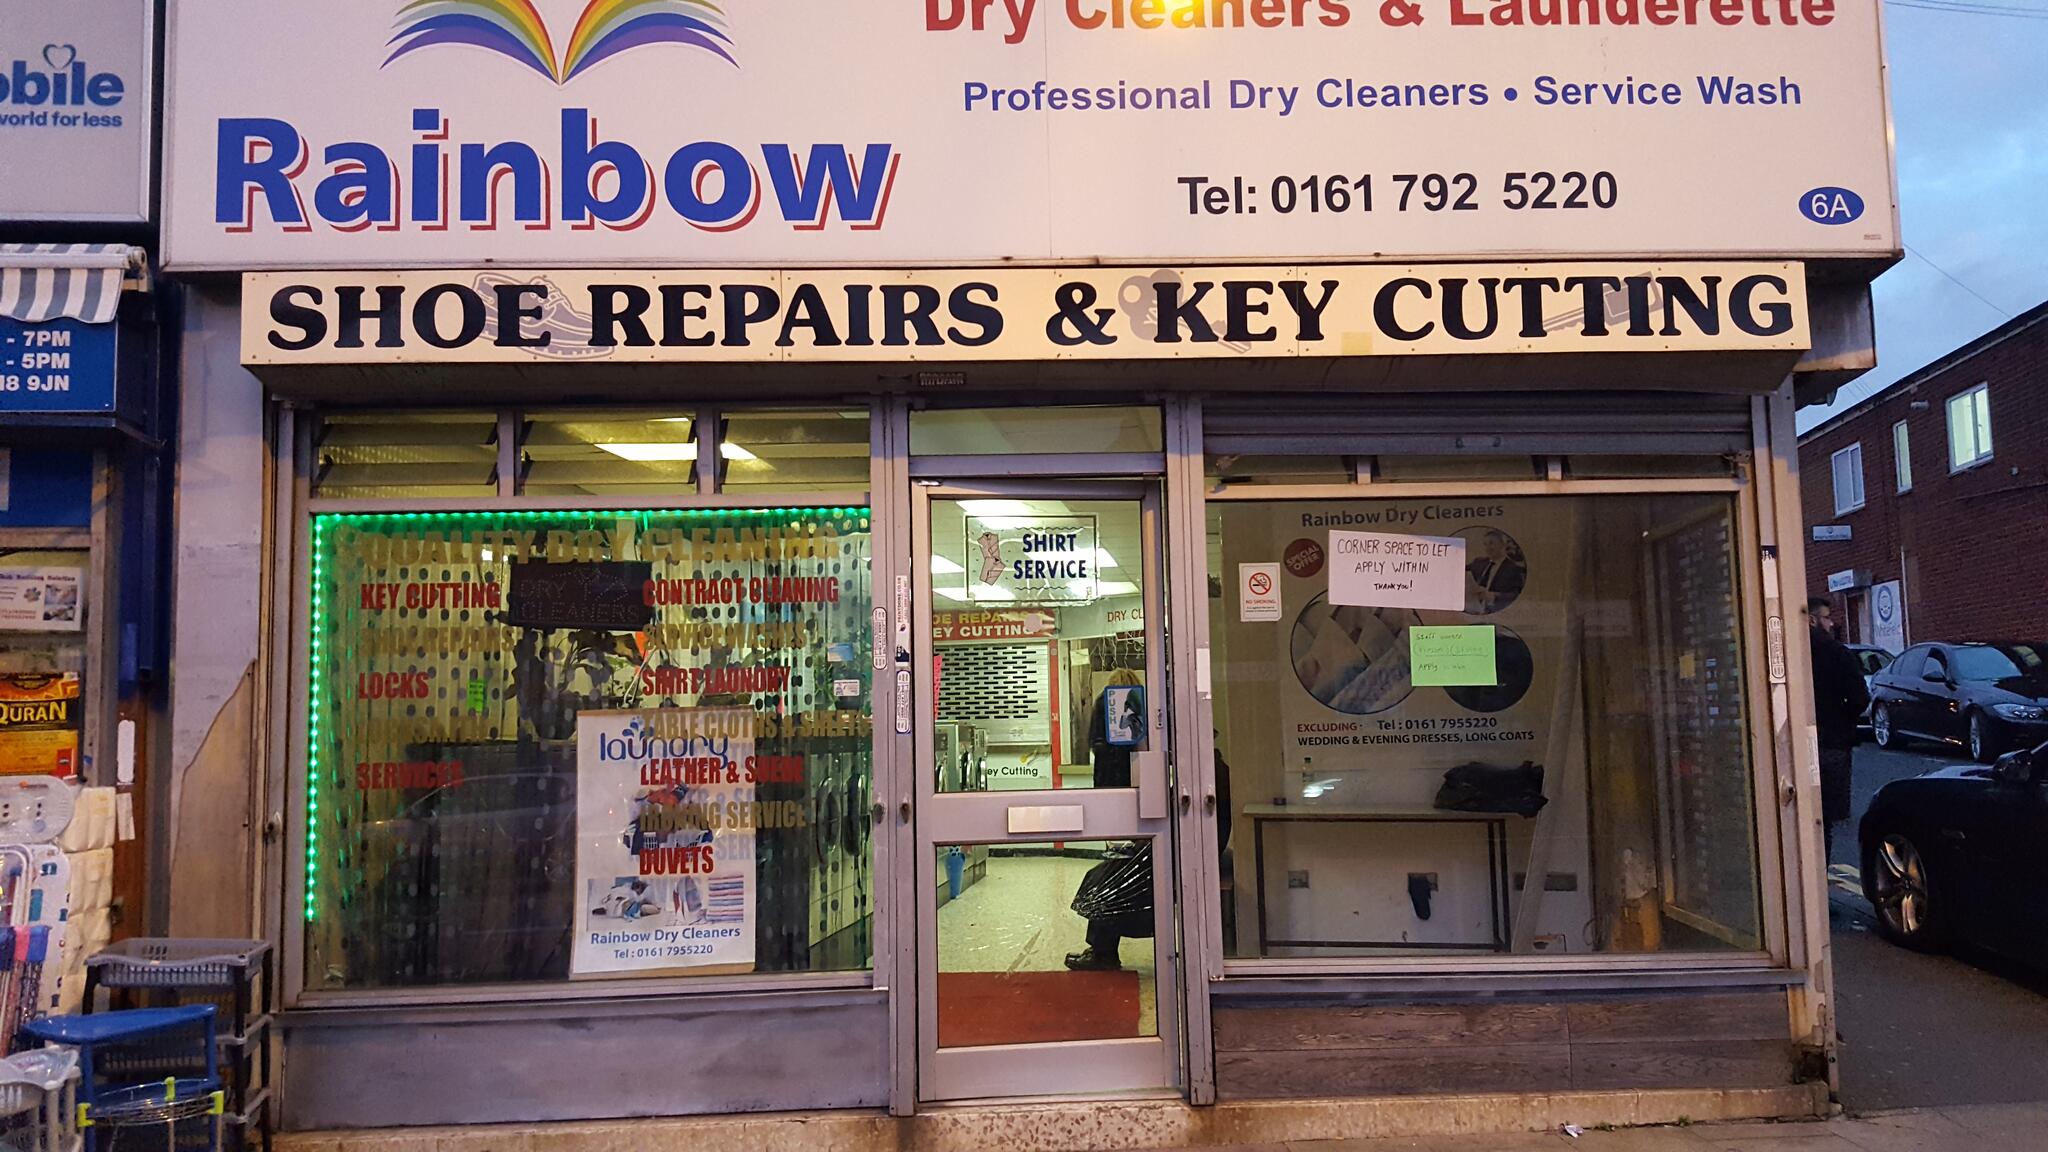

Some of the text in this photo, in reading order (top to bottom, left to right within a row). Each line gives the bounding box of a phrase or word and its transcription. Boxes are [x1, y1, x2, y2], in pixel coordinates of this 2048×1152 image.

[925, 0, 1836, 44] Dry Cleaners & Launderette
[0, 44, 124, 106] bile
[964, 74, 1801, 116] Professional Dry Cleaners Service Wash
[52, 111, 80, 127] for
[83, 111, 122, 127] less
[214, 107, 901, 233] Rainbow
[1177, 170, 1619, 215] Tel: 0161 792 5220
[1811, 192, 1852, 220] 6A
[267, 274, 1794, 351] SHOE REPAIRS & KEY CUTTING
[23, 330, 71, 347] 7PM
[21, 352, 71, 369] 5PM
[26, 374, 70, 391] 9JN
[1301, 502, 1505, 528] Rainbow Dry Cleaners
[362, 527, 840, 568] QUALITY DRY CLEANING
[1022, 533, 1077, 552] SHIRT
[1285, 544, 1320, 567] SPECIAL
[1337, 538, 1450, 557] CORNER SPACE TO LET
[1013, 560, 1088, 579] SERVICE
[1294, 553, 1321, 571] OFFER
[1354, 560, 1430, 575] APPLY WITHIN
[361, 581, 500, 610] KEY CUTTING
[642, 575, 839, 606] CONTRACT CLEANING
[1107, 608, 1145, 623] DRY CL
[643, 622, 808, 650] SERVICE WASHES
[358, 671, 429, 700] LOCKS
[642, 665, 790, 696] SHIRT LAUNDRY
[643, 713, 699, 741] TABLE
[704, 711, 777, 740] CLOTHS
[1297, 722, 1358, 733] EXCLUDING
[1405, 718, 1436, 730] 0161
[1440, 717, 1498, 729] 7955220
[1297, 730, 1535, 746] WEDDING & EVENING DRESSES, LONG COATS
[355, 761, 465, 790] SERVICES
[640, 757, 721, 786] LEATHER
[726, 760, 740, 784] &
[986, 765, 1038, 777] ey Cutting
[639, 799, 807, 833] IRONING SERVICE
[639, 845, 715, 876] DUVETS
[591, 926, 741, 945] Rainbow Dry Cleaners
[637, 947, 664, 958] 0161
[666, 944, 713, 956] 7955220
